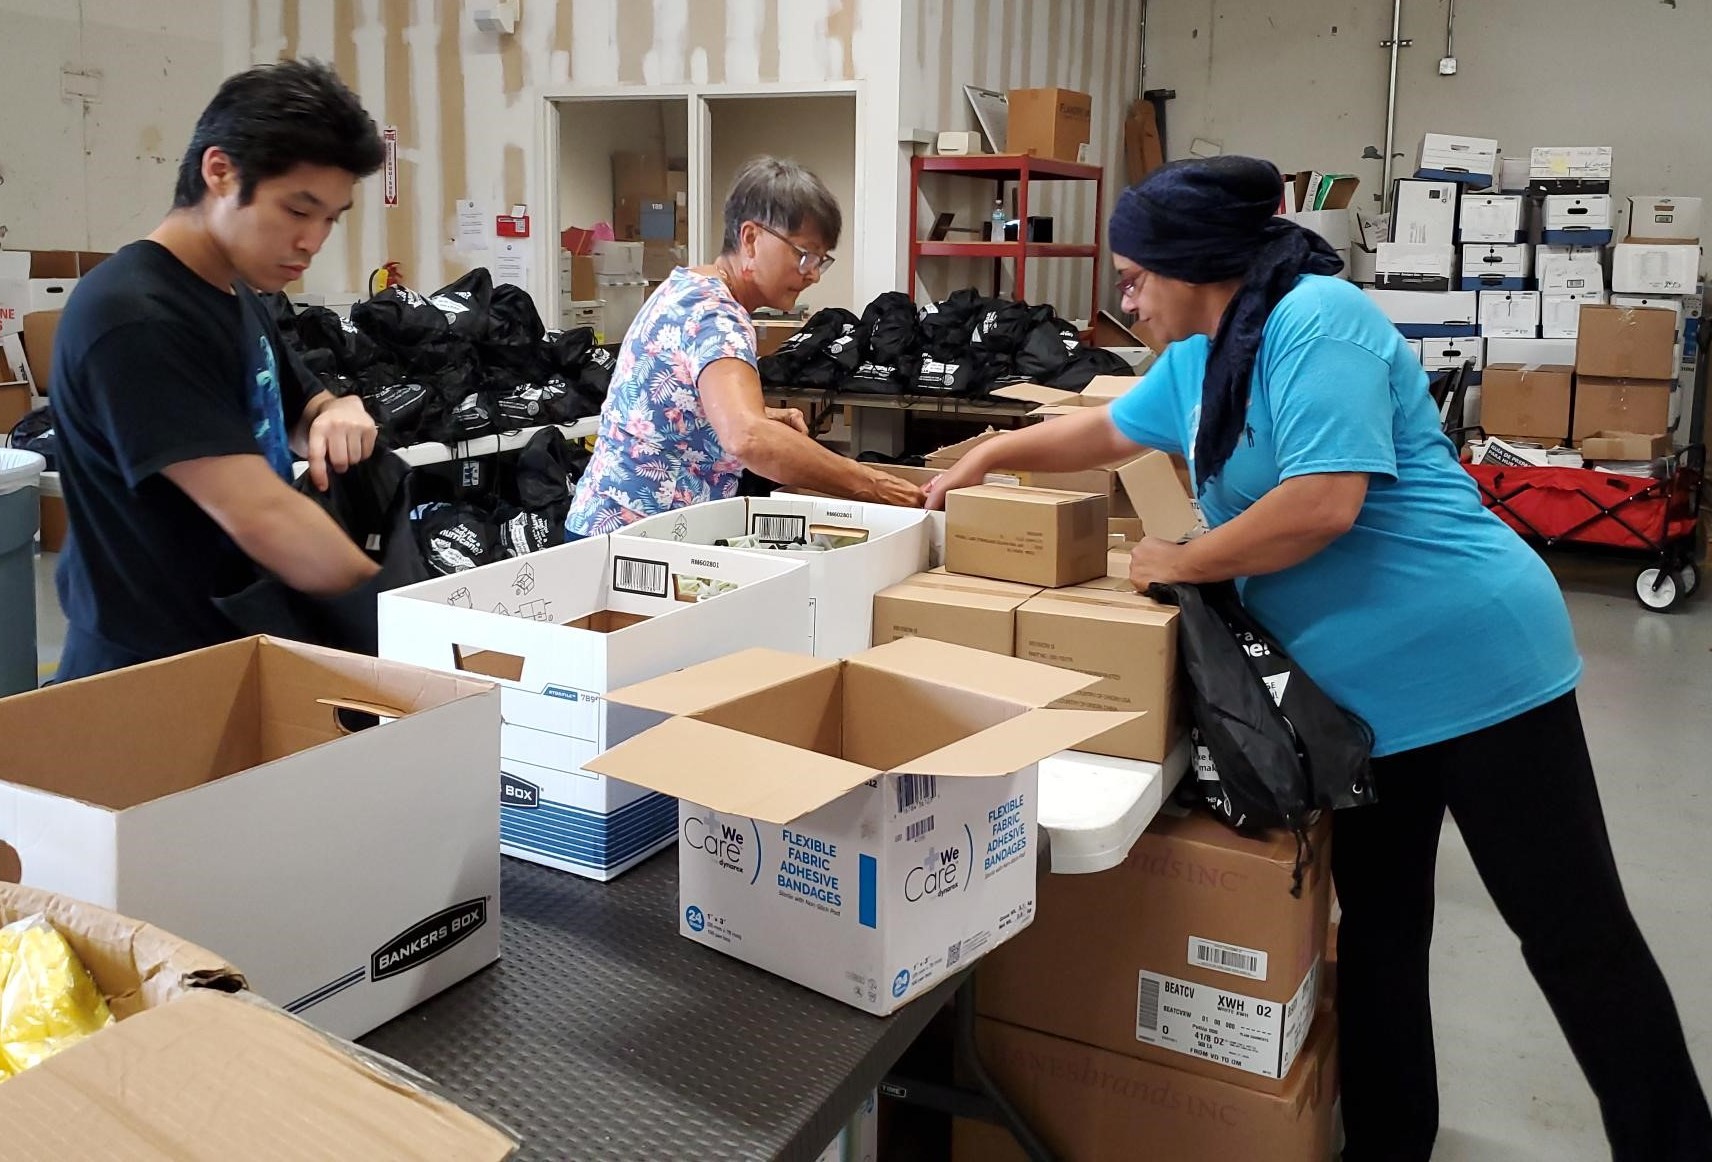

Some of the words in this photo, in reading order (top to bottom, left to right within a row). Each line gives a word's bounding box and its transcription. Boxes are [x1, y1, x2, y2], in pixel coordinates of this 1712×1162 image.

[1488, 450, 1501, 461] PARA
[439, 529, 484, 556] hurricane?
[505, 785, 533, 801] BOX
[987, 794, 1024, 823] FLEXIBLE
[721, 824, 744, 845] We
[992, 811, 1021, 836] FABRIC
[684, 817, 741, 862] Care
[782, 829, 837, 858] FLEXIBLE
[986, 823, 1025, 854] ADHESIVE
[788, 847, 831, 871] FABRIC
[940, 847, 960, 865] We
[984, 837, 1027, 871] BANDAGES
[780, 861, 839, 890] ADHESIVE
[904, 863, 957, 902] Care
[777, 873, 842, 907] BANDAGES
[688, 909, 703, 924] 24
[379, 926, 448, 970] BANKERS
[451, 909, 480, 932] BOX
[1164, 981, 1195, 999] BEATCV
[1217, 995, 1245, 1012] XWH
[1256, 1005, 1272, 1018] 02
[1190, 1048, 1208, 1056] FROM
[1213, 1036, 1225, 1046] DZ
